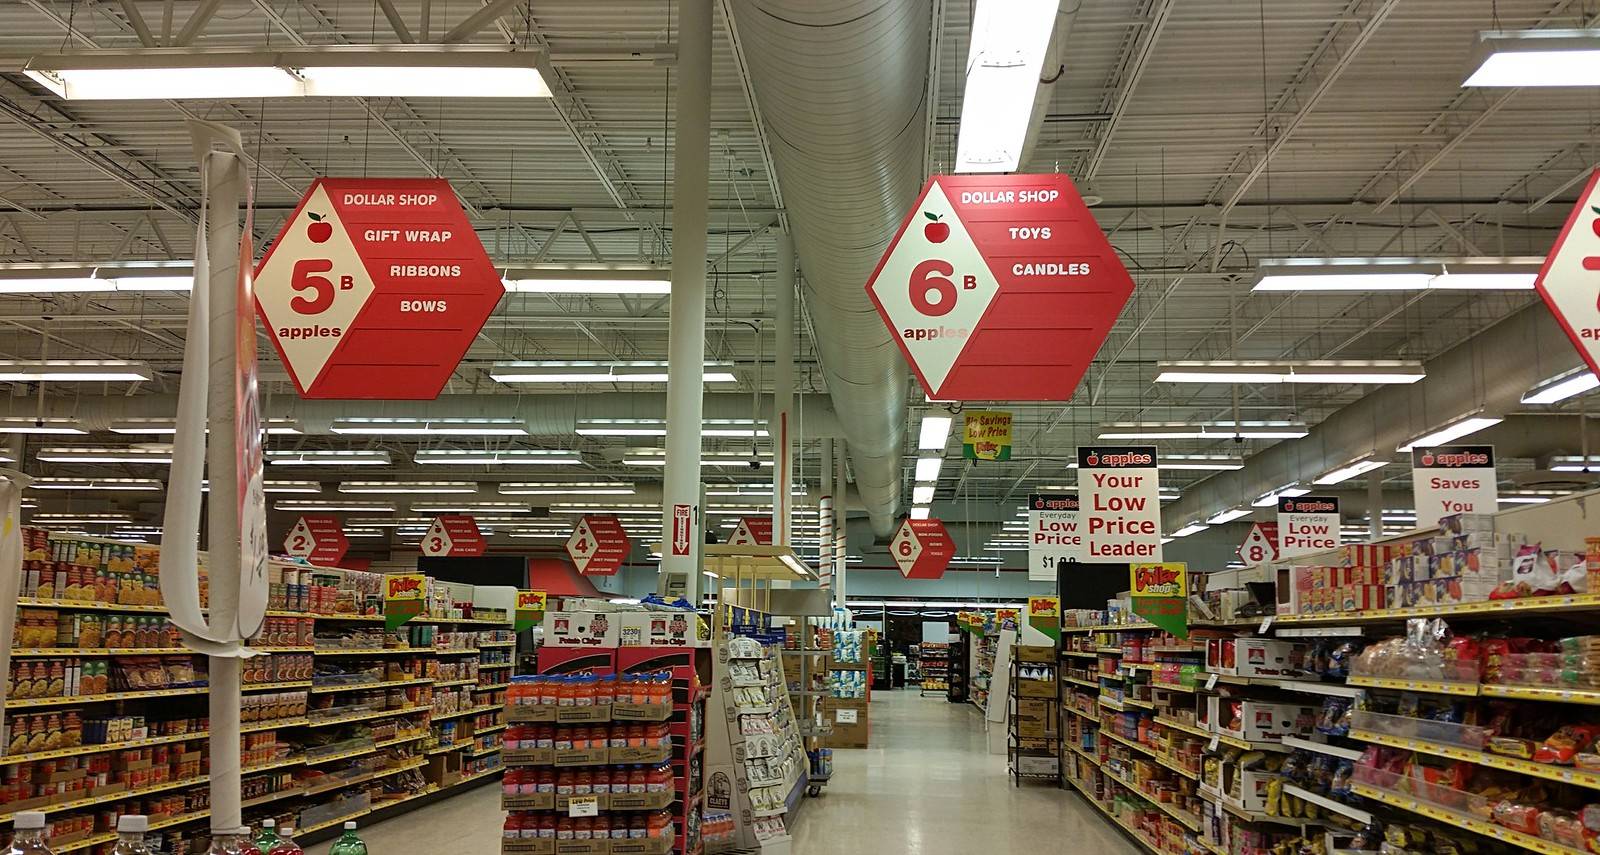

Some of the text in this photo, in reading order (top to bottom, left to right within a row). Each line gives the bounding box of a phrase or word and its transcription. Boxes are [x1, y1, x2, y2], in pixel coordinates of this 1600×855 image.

[344, 194, 437, 206] DOLLAR SHOP
[961, 190, 1059, 204] DOLLAR SHOP
[364, 230, 452, 243] GIFT WRAP
[1009, 227, 1051, 239] TOYS
[390, 265, 461, 277] RIBBONS
[1012, 263, 1090, 276] CANDLES
[290, 259, 354, 315] 5 B
[908, 259, 977, 316] 6 B
[400, 301, 447, 312] BOWS
[279, 325, 342, 339] apples
[904, 326, 968, 340] apples
[980, 416, 1012, 426] Savings
[969, 427, 1008, 438] Low Price
[1101, 452, 1152, 467] apples
[1437, 451, 1488, 465] apples
[1092, 474, 1143, 488] Your
[1431, 477, 1480, 489] Saves
[1094, 493, 1146, 511] Low
[1296, 501, 1335, 512] apples
[1441, 500, 1473, 512] You
[1039, 511, 1076, 520] Everyday
[1290, 514, 1327, 522] Everyday
[1039, 520, 1077, 532] Low
[1089, 517, 1155, 535] Price
[1288, 523, 1329, 535] Low
[292, 535, 305, 551] 2
[430, 537, 442, 552] 3
[575, 538, 588, 553] 4
[1034, 533, 1081, 545] Price
[1284, 536, 1335, 548] Price
[899, 540, 912, 556] 6
[1090, 541, 1156, 556] Leader
[1249, 545, 1264, 561] 8
[1135, 565, 1181, 592] Dollar
[1148, 583, 1171, 594] shop
